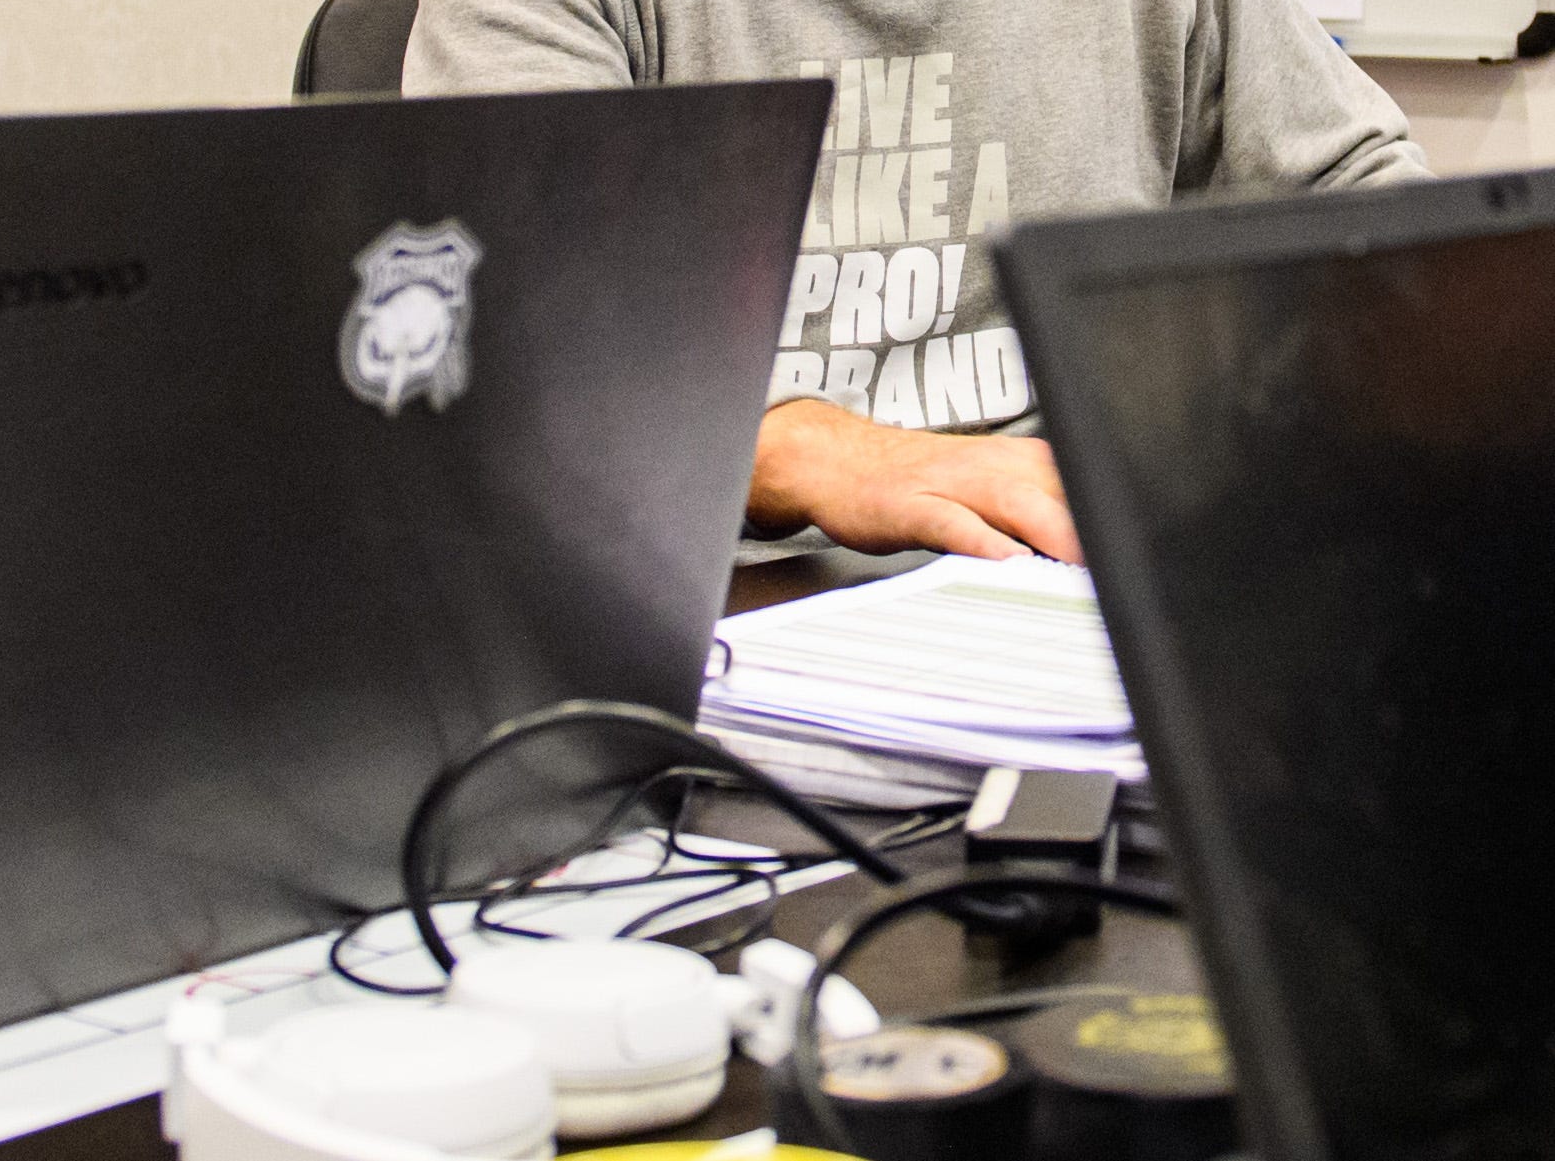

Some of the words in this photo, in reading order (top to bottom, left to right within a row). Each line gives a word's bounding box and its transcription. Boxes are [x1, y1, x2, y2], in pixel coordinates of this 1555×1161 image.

[800, 52, 953, 150] IVE
[967, 142, 1009, 235] A
[779, 244, 966, 347] PRO!
